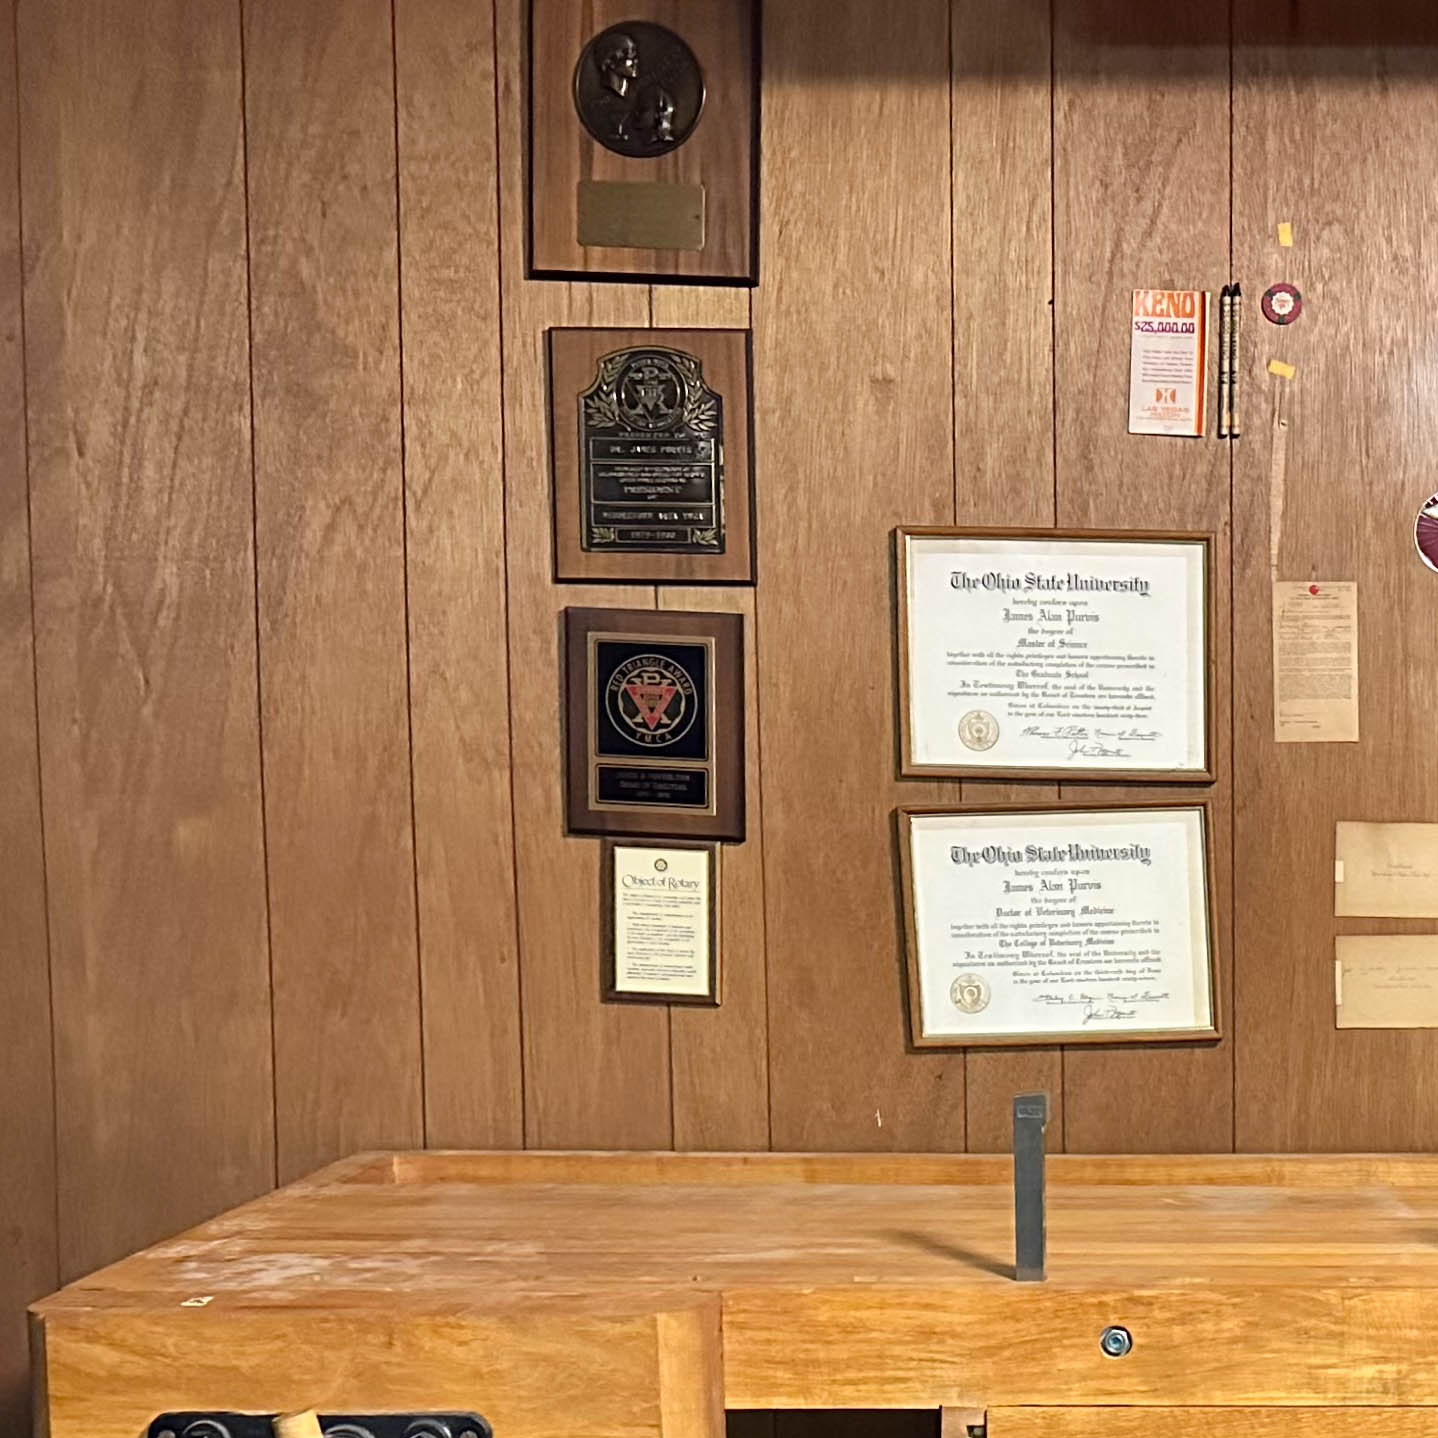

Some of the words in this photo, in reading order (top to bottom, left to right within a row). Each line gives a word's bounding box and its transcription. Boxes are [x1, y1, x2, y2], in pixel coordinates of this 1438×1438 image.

[1134, 291, 1195, 319] KENO
[1134, 321, 1195, 334] $25,000.00
[950, 571, 981, 593] The
[981, 571, 1022, 594] Ohio
[1023, 571, 1065, 594] State
[1066, 571, 1152, 597] University
[950, 845, 981, 867] The
[981, 845, 1023, 867] Ohio
[1024, 844, 1067, 864] State
[1066, 843, 1152, 867] University
[622, 874, 656, 889] Object
[656, 877, 666, 887] of
[668, 877, 701, 891] Rotary
